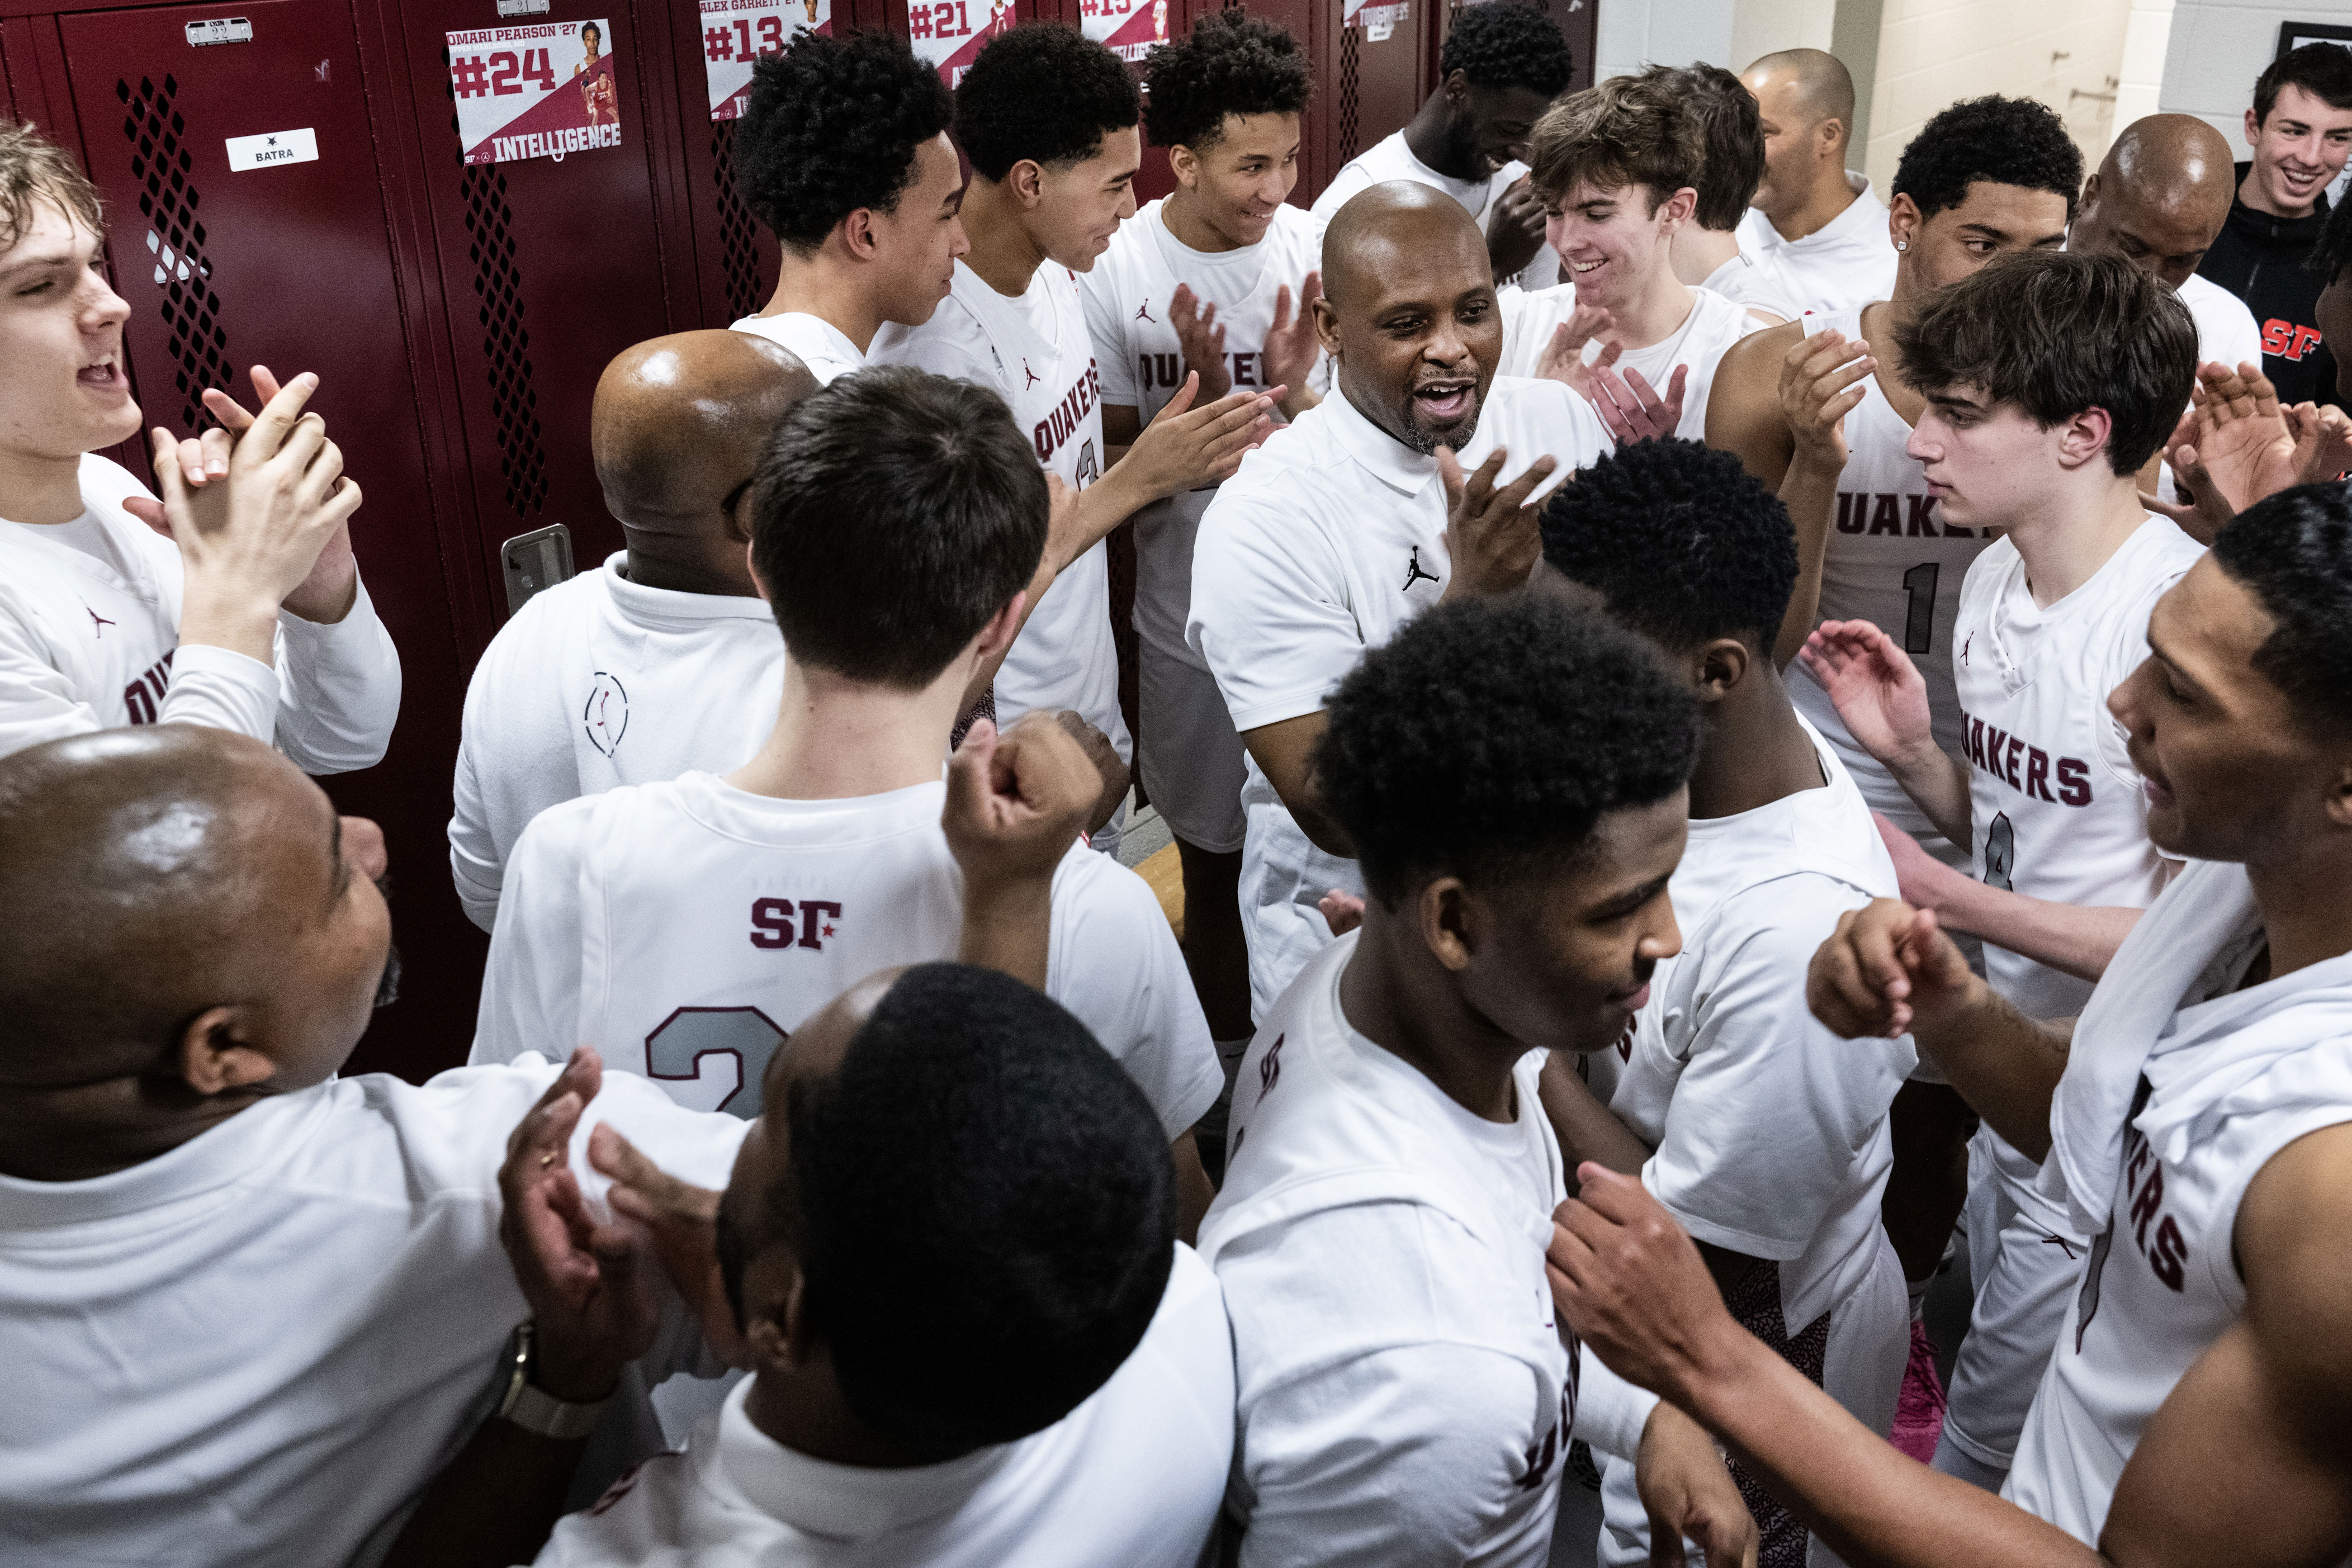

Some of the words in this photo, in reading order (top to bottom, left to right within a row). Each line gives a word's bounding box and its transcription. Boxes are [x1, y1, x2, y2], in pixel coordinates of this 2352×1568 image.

[699, 1, 728, 13] ALEX
[910, 1, 972, 40] #21
[212, 26, 228, 40] 22
[447, 31, 492, 45] OMARI
[495, 26, 556, 41] PEARSON
[705, 16, 783, 63] #13
[452, 48, 556, 99] #24
[255, 149, 294, 162] BATRA
[465, 155, 475, 163] SF
[492, 122, 621, 163] INTELLIGENCE
[2261, 318, 2322, 362] SF
[1034, 357, 1100, 463] QUAKERS
[1903, 562, 1939, 654] 1
[1959, 709, 2094, 808] UAKERS
[750, 897, 841, 951] SF
